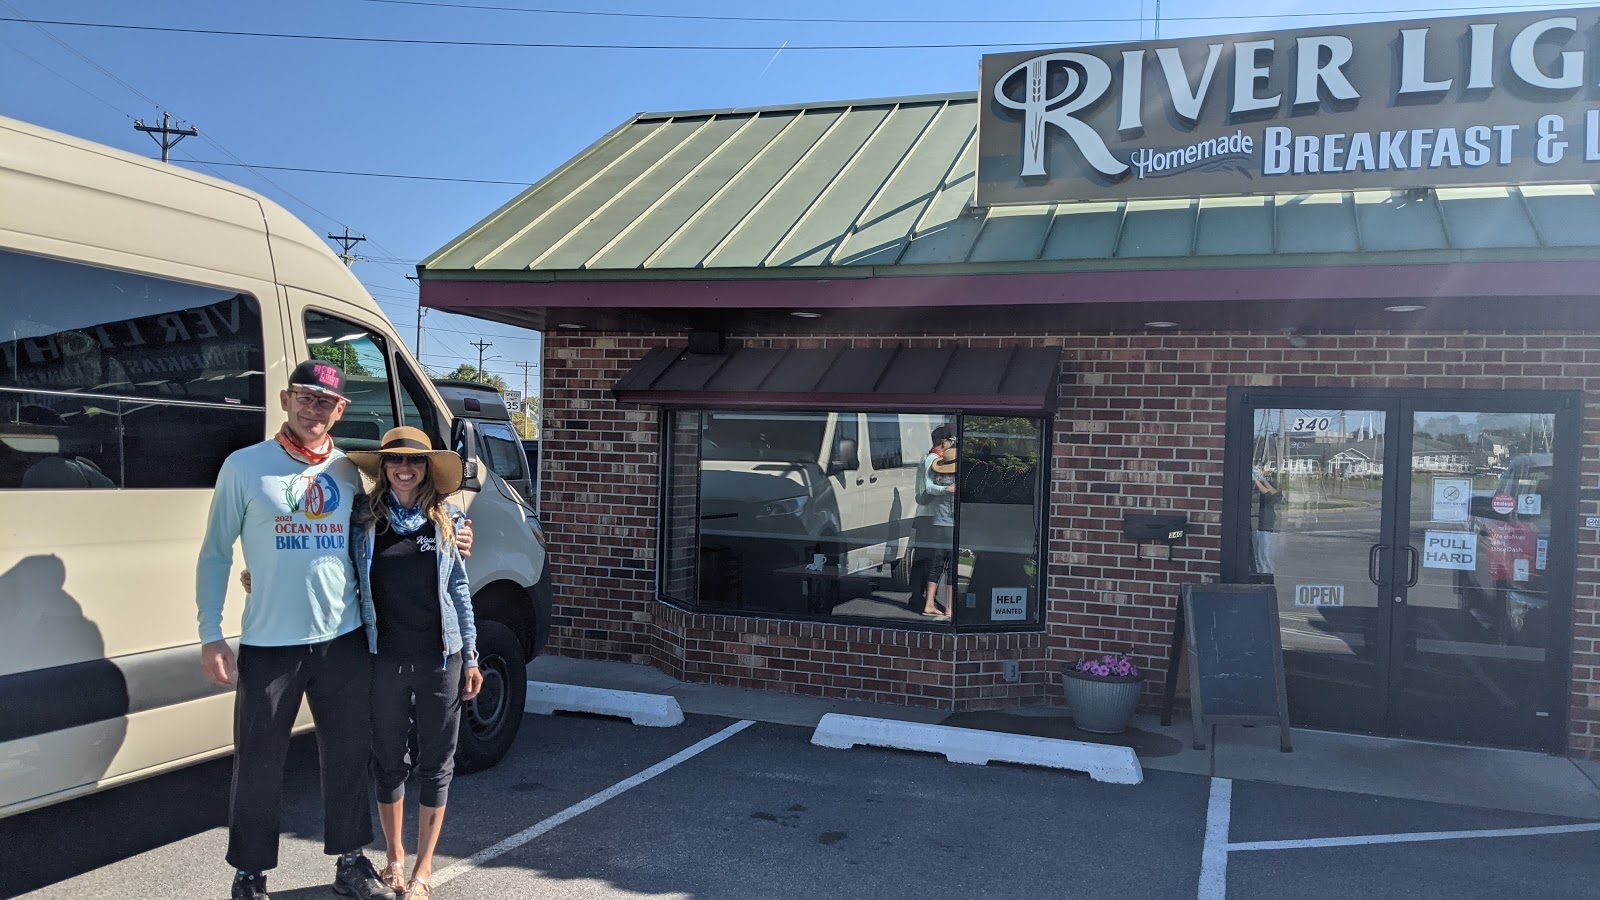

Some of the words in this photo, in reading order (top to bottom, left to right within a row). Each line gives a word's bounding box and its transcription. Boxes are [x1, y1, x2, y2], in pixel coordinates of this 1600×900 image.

[994, 35, 1361, 178] RIVER
[1399, 17, 1600, 94] LIG
[1264, 125, 1519, 175] BREAKFAST
[1537, 114, 1569, 164] &
[1131, 130, 1253, 179] Homemade
[506, 402, 518, 410] 35
[1293, 417, 1329, 431] 340
[275, 523, 312, 534] OCEAN
[315, 523, 327, 534] TO
[330, 523, 344, 534] BAY
[276, 535, 310, 550] BIKE
[314, 535, 345, 549] TOUR
[1429, 537, 1472, 550] PULL
[1425, 551, 1473, 564] HARD
[996, 595, 1022, 604] HELP
[1299, 586, 1341, 605] OPEN
